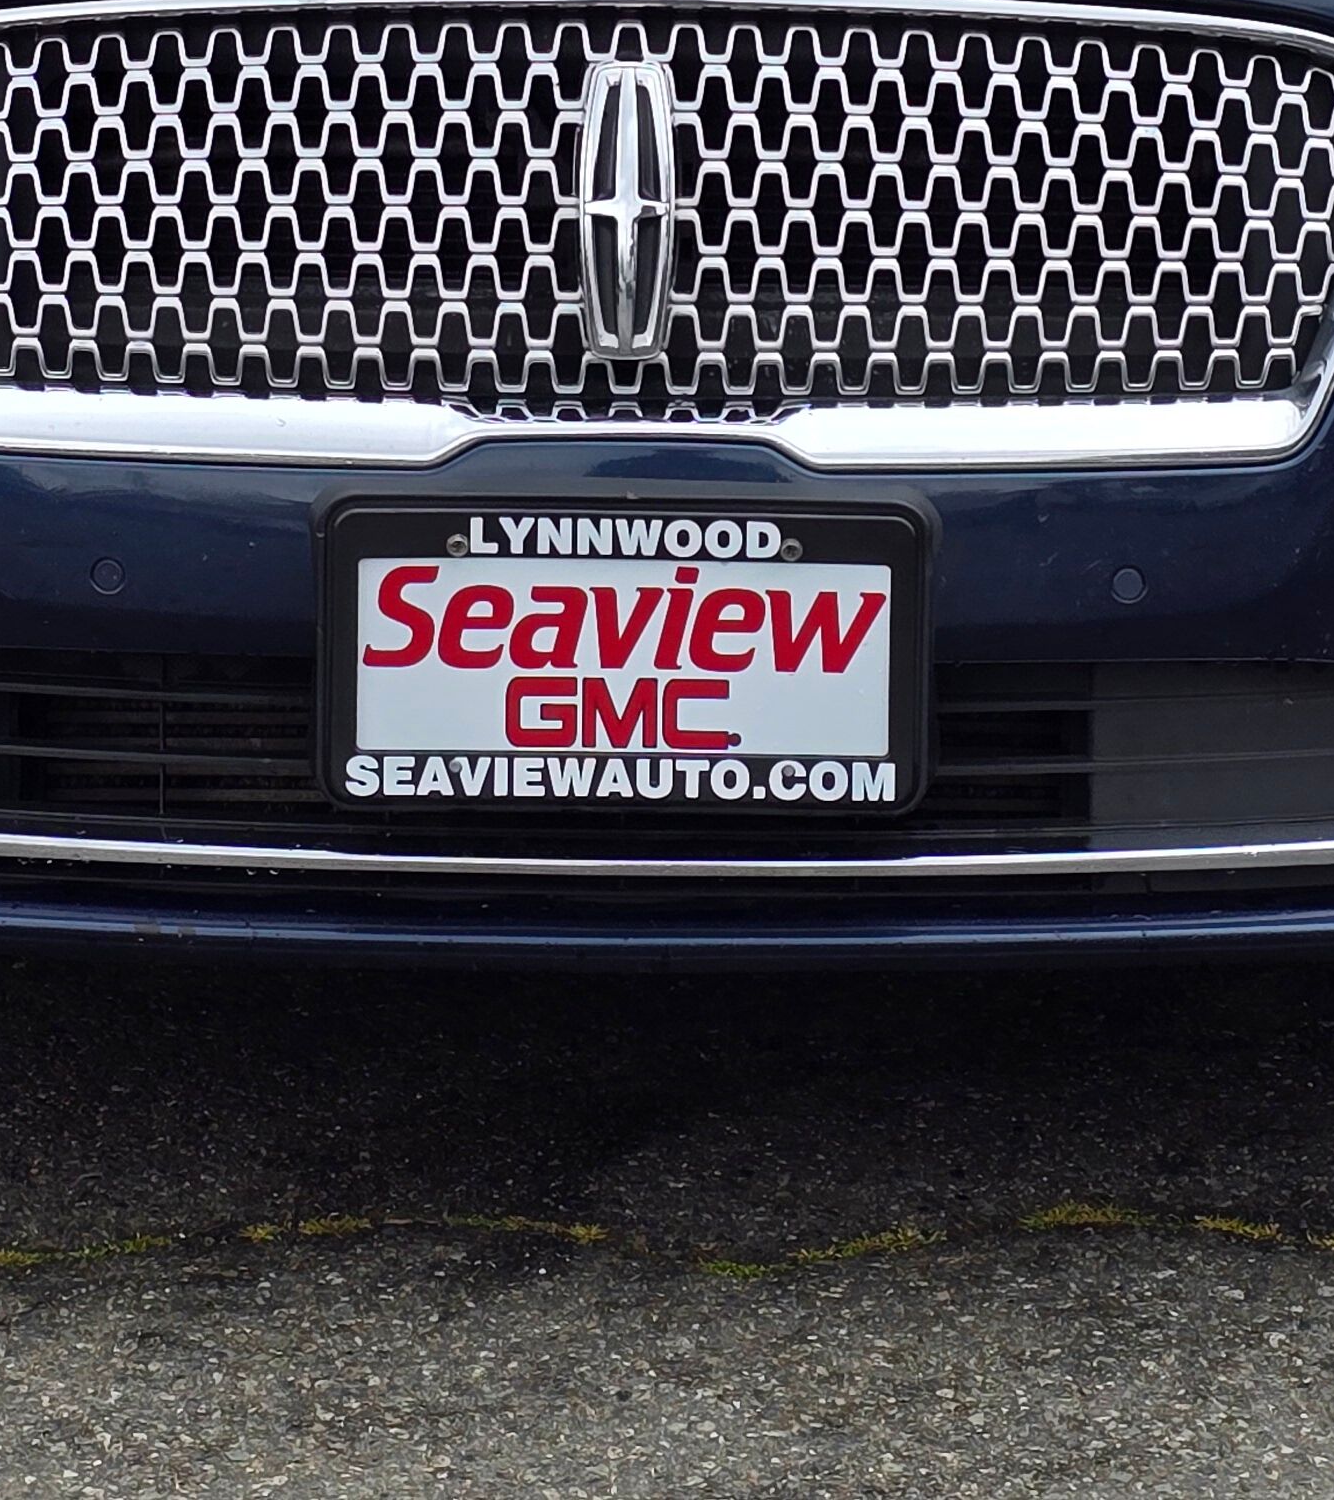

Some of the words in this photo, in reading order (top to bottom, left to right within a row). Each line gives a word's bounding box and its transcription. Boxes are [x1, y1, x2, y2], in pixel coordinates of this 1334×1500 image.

[469, 517, 782, 559] LYNNWOOD
[362, 566, 887, 674] Seaview
[504, 676, 731, 750] GMC
[345, 754, 896, 803] SEAVIEWAUTO.COM
